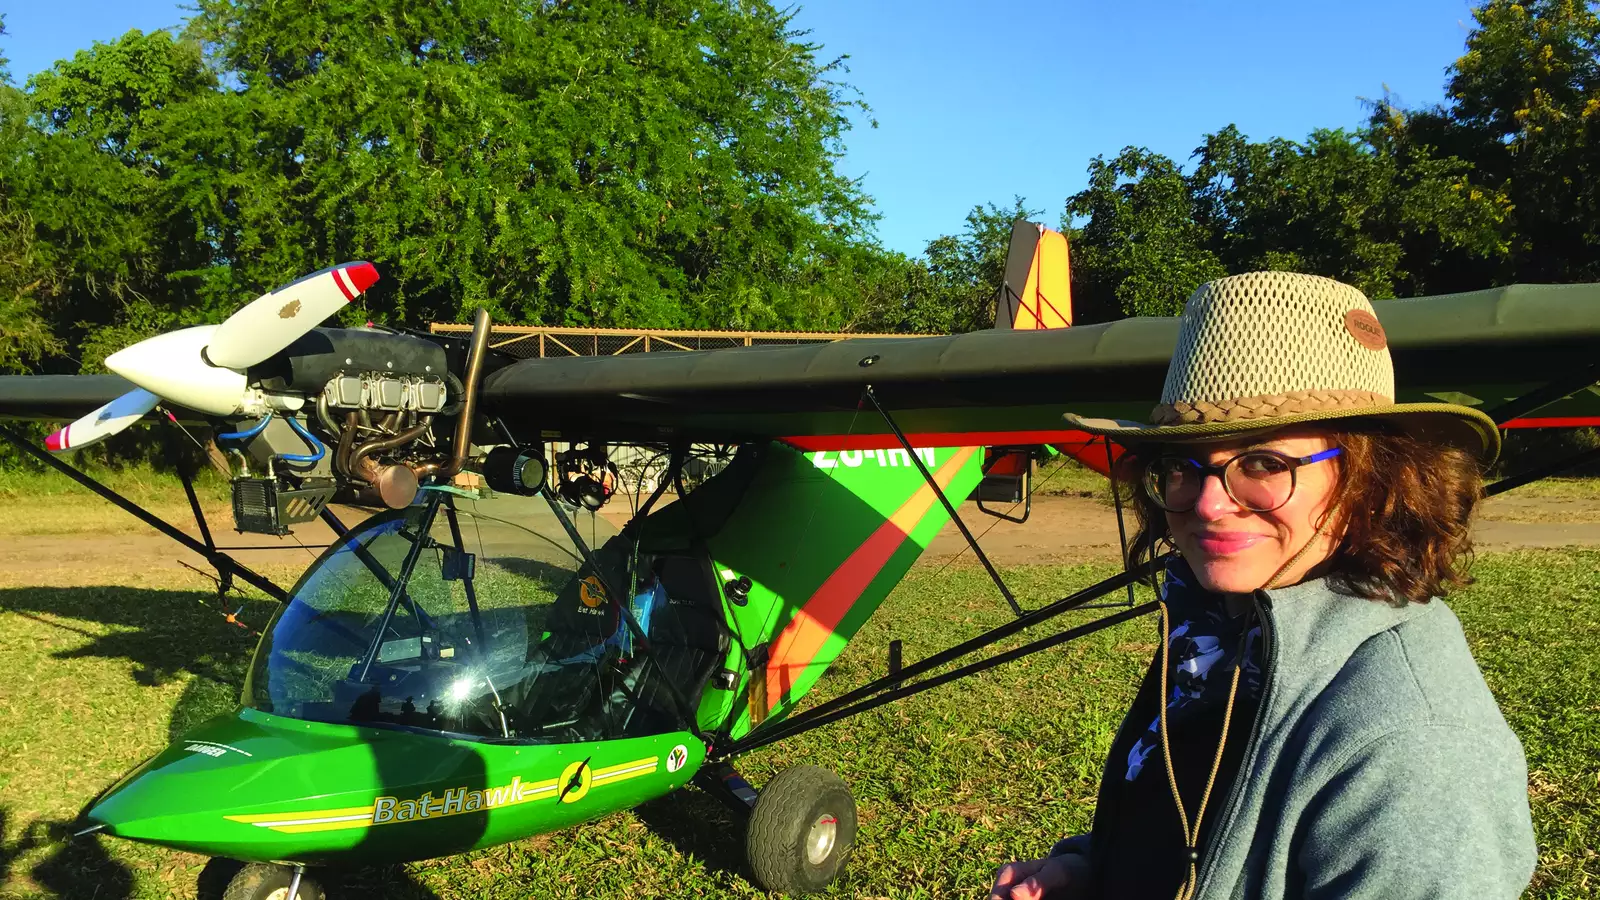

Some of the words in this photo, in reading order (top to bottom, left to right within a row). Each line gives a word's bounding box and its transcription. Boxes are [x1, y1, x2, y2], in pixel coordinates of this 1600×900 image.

[1354, 319, 1381, 337] ROGUE
[184, 743, 227, 758] DANGER
[373, 777, 525, 823] Bat-Hawk
